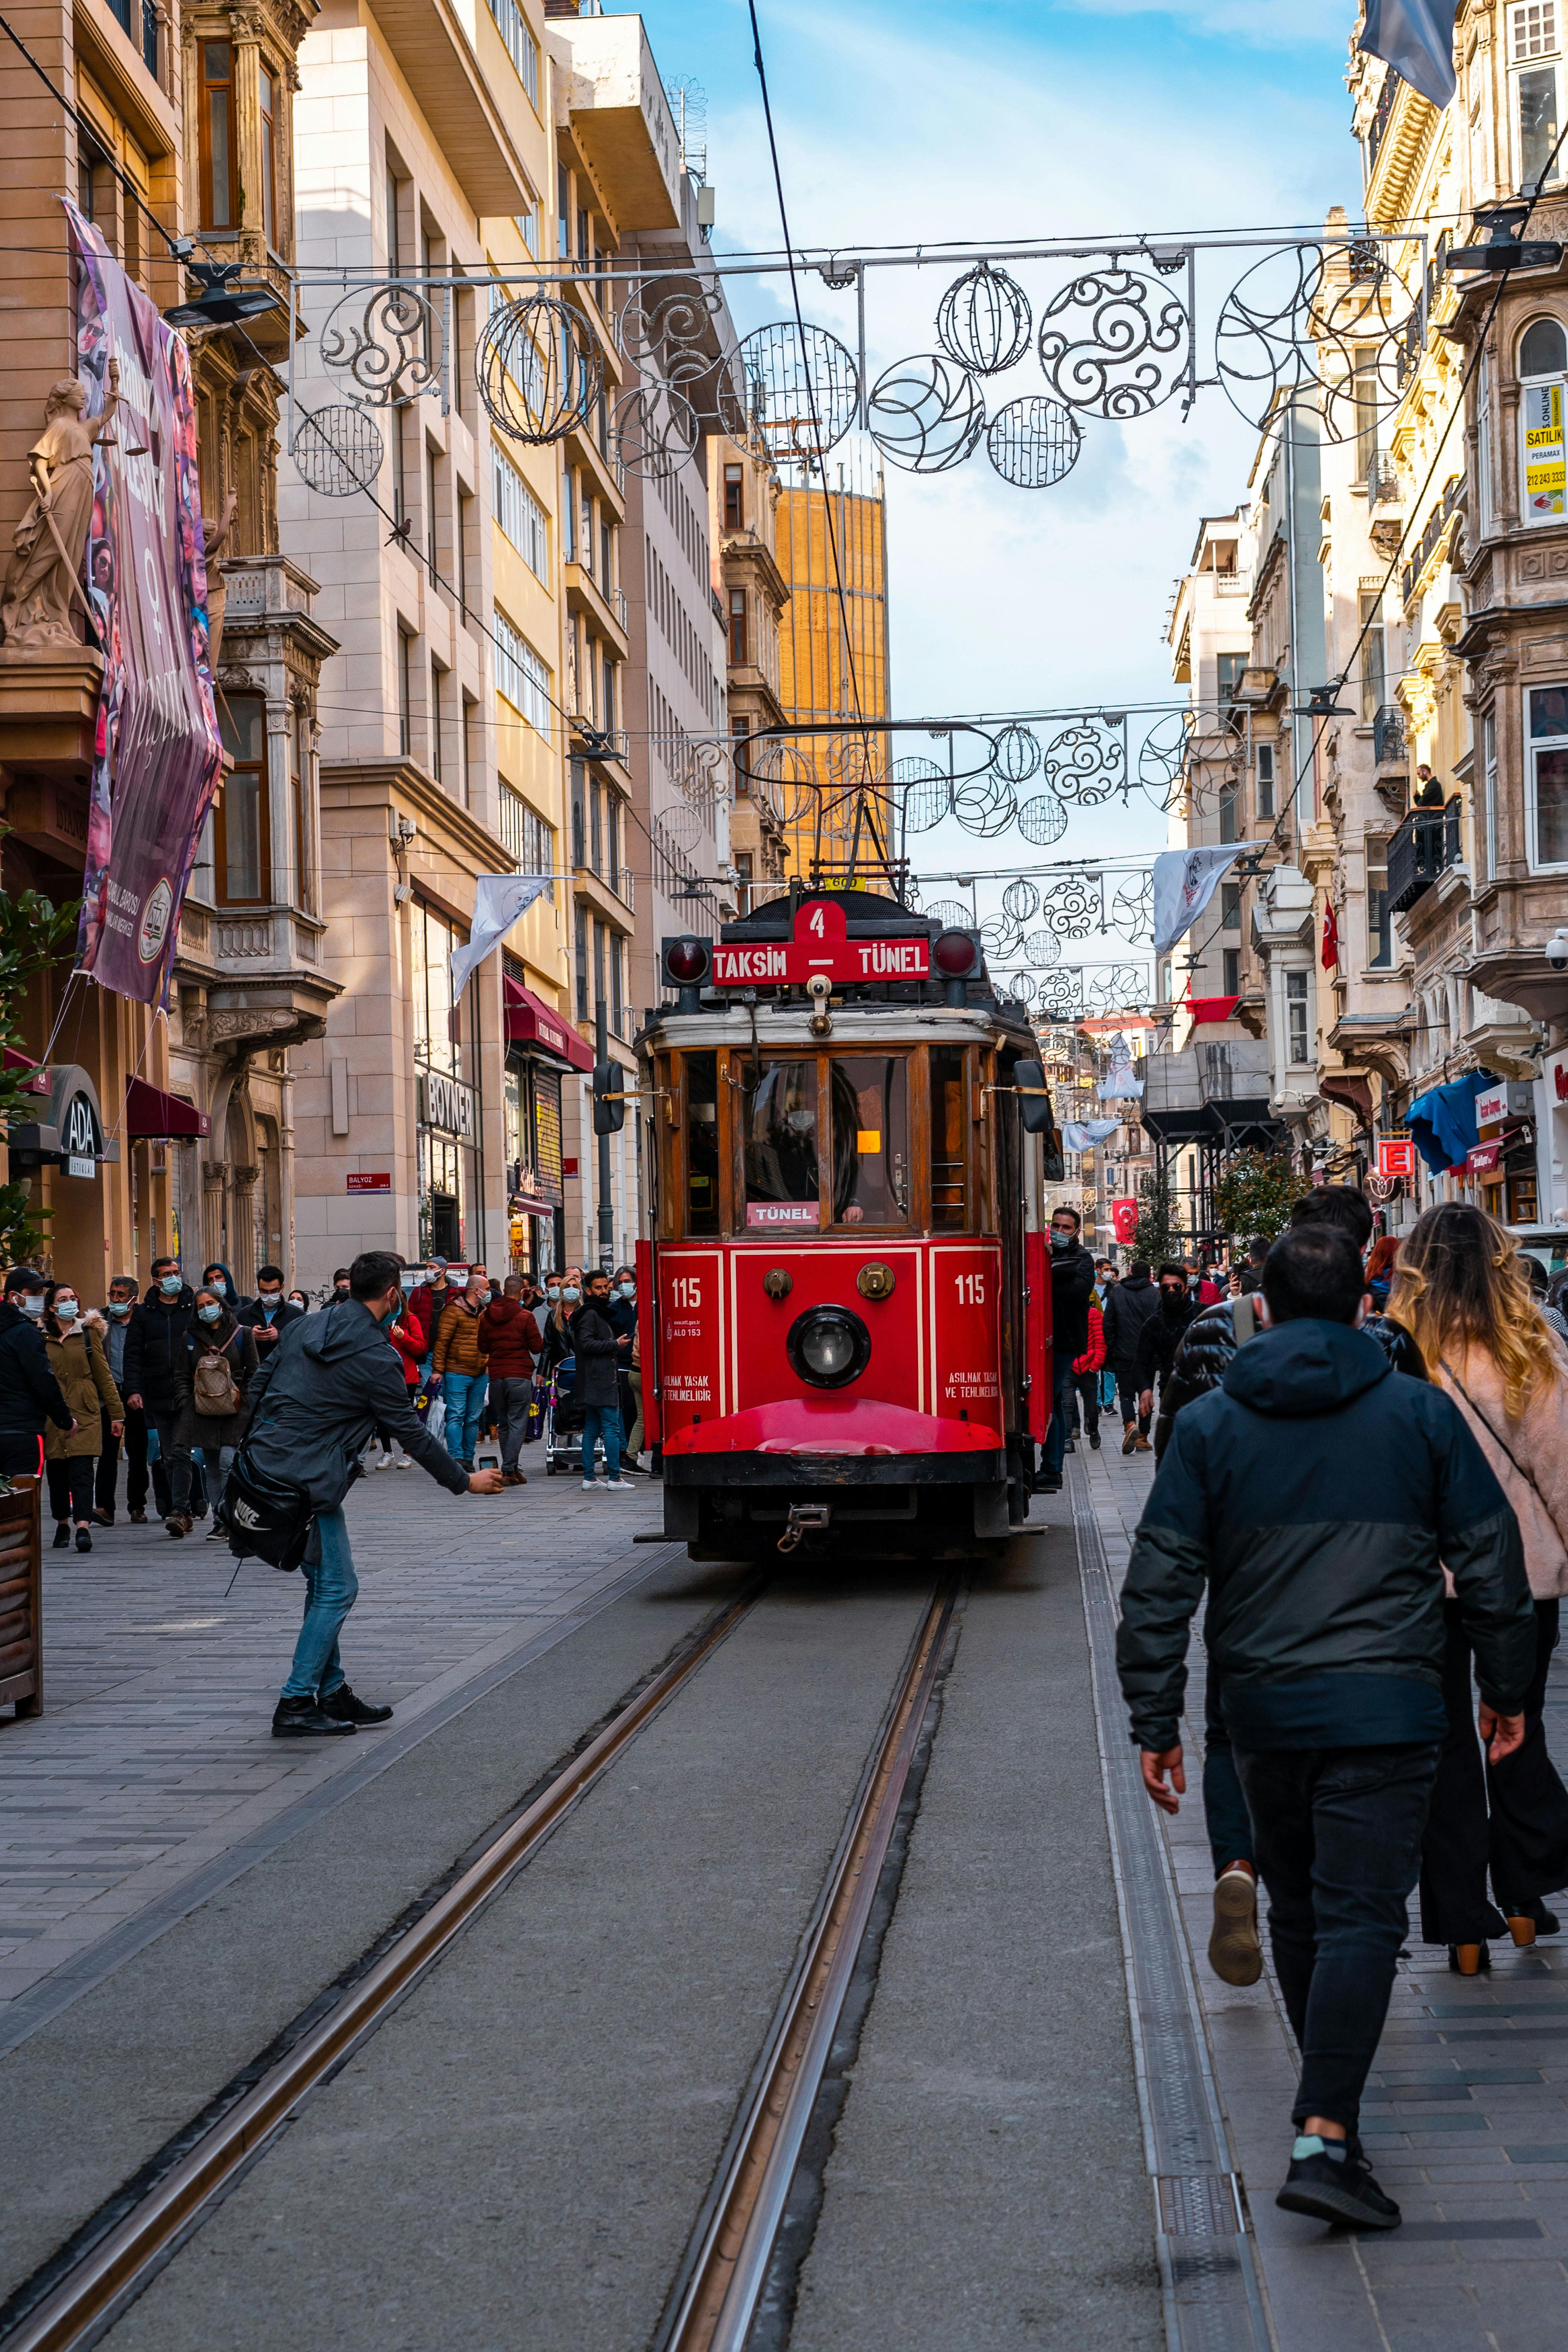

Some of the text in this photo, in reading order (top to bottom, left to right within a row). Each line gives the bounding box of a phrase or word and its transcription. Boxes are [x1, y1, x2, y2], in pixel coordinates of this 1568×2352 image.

[1528, 429, 1563, 445] SATILIK
[1532, 450, 1560, 459] PERAMAX
[1527, 471, 1565, 486] 212 243 3333
[833, 878, 857, 887] 600
[810, 908, 824, 938] 4
[713, 946, 786, 978] TAKSİM
[858, 943, 928, 973] TÜNEL
[428, 1073, 472, 1136] BOYNER
[70, 1101, 95, 1154] ADA
[1387, 1146, 1406, 1171] E
[756, 1207, 812, 1220] TÜNEL
[672, 1278, 701, 1307] 115
[955, 1274, 984, 1304] 115
[684, 1376, 708, 1387] YASAK
[668, 1388, 711, 1401] TEHLİKELİDİR
[945, 1387, 956, 1398] VE
[236, 1497, 260, 1526] NIKE
